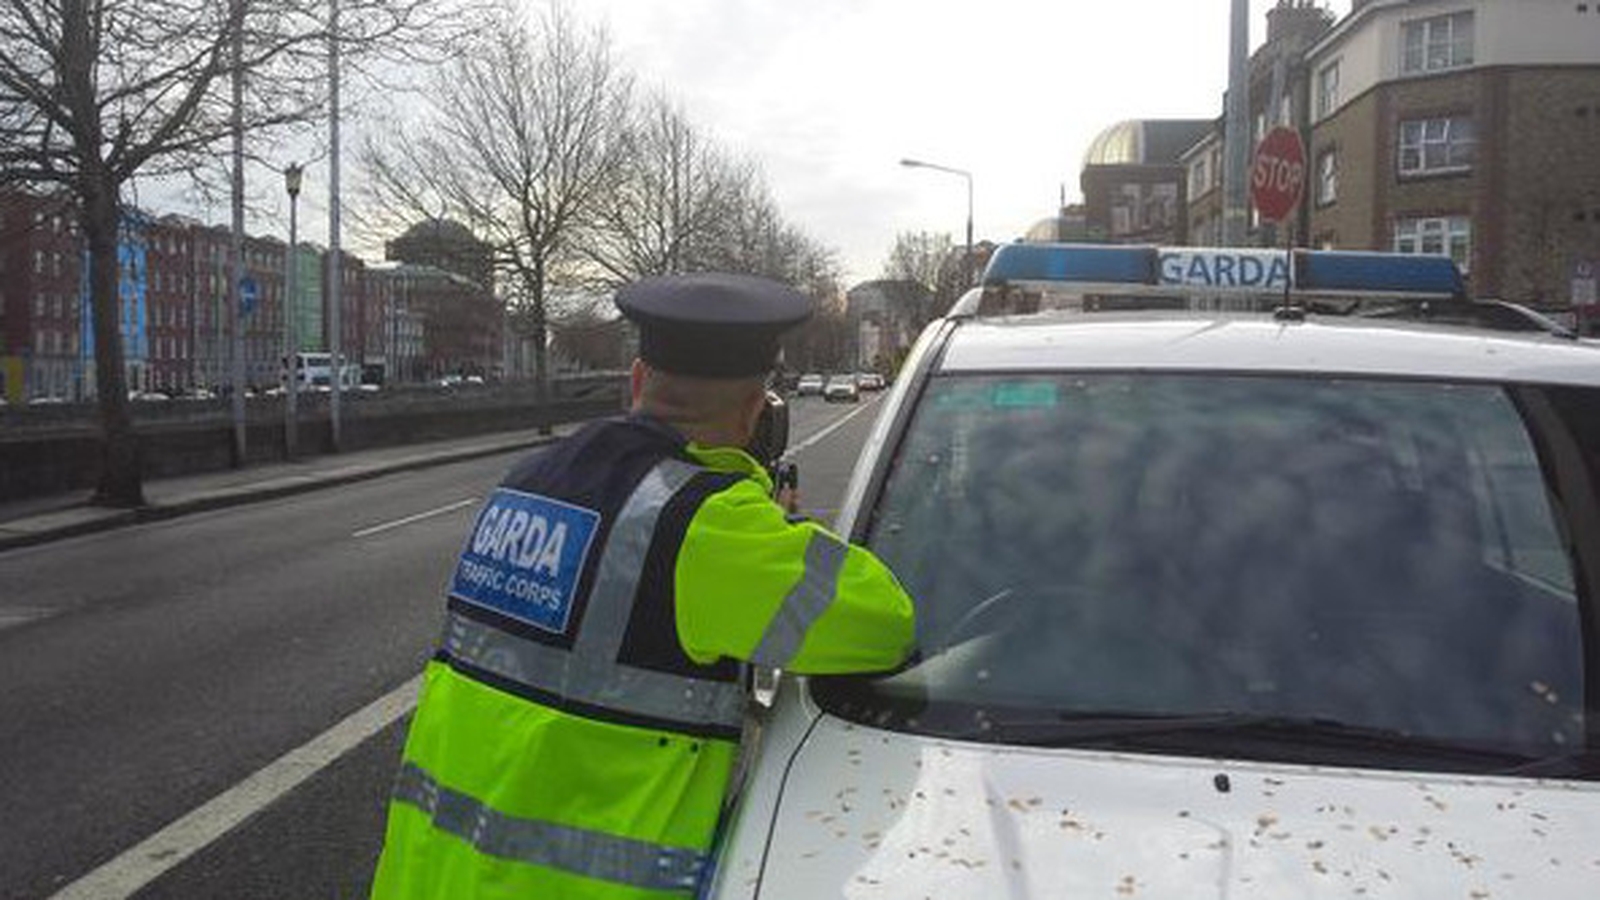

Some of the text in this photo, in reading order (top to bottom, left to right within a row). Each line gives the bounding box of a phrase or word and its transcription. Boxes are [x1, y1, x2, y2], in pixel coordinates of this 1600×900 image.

[1253, 155, 1301, 193] STOP
[1159, 252, 1292, 288] GARDA
[472, 505, 568, 577] GARDA
[505, 574, 563, 610] CORPS
